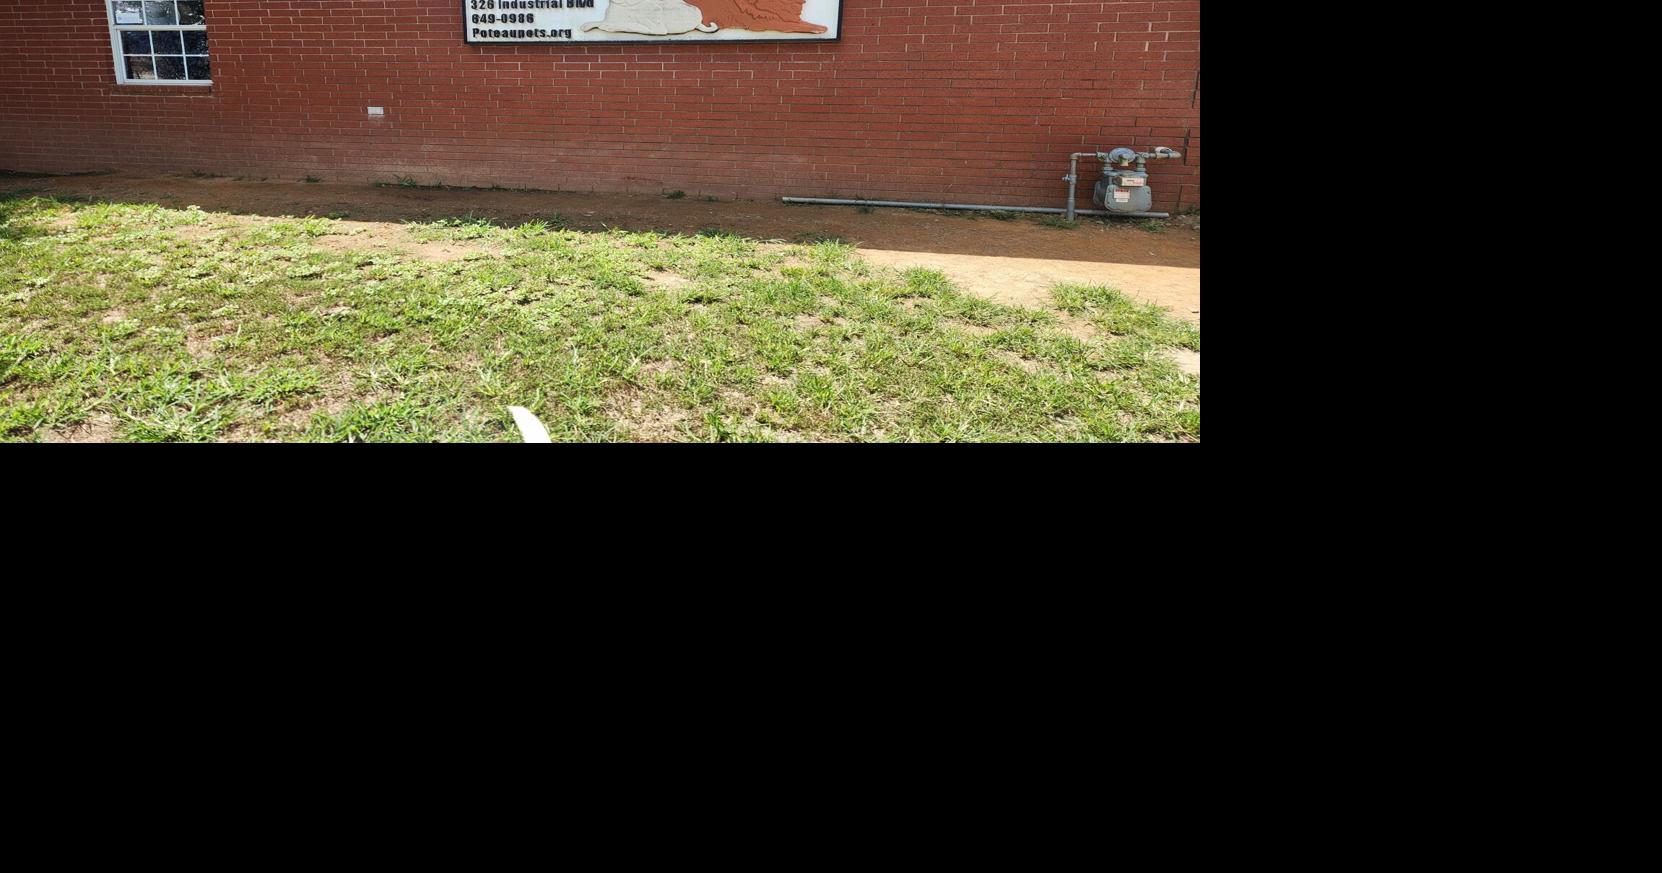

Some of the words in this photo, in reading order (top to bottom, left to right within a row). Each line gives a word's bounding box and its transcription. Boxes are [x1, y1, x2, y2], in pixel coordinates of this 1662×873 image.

[471, 0, 494, 9] 326
[498, 0, 563, 9] Industrial
[566, 0, 594, 8] Blvd
[472, 13, 534, 24] 649-0986
[472, 28, 572, 39] Poteaupets.org
